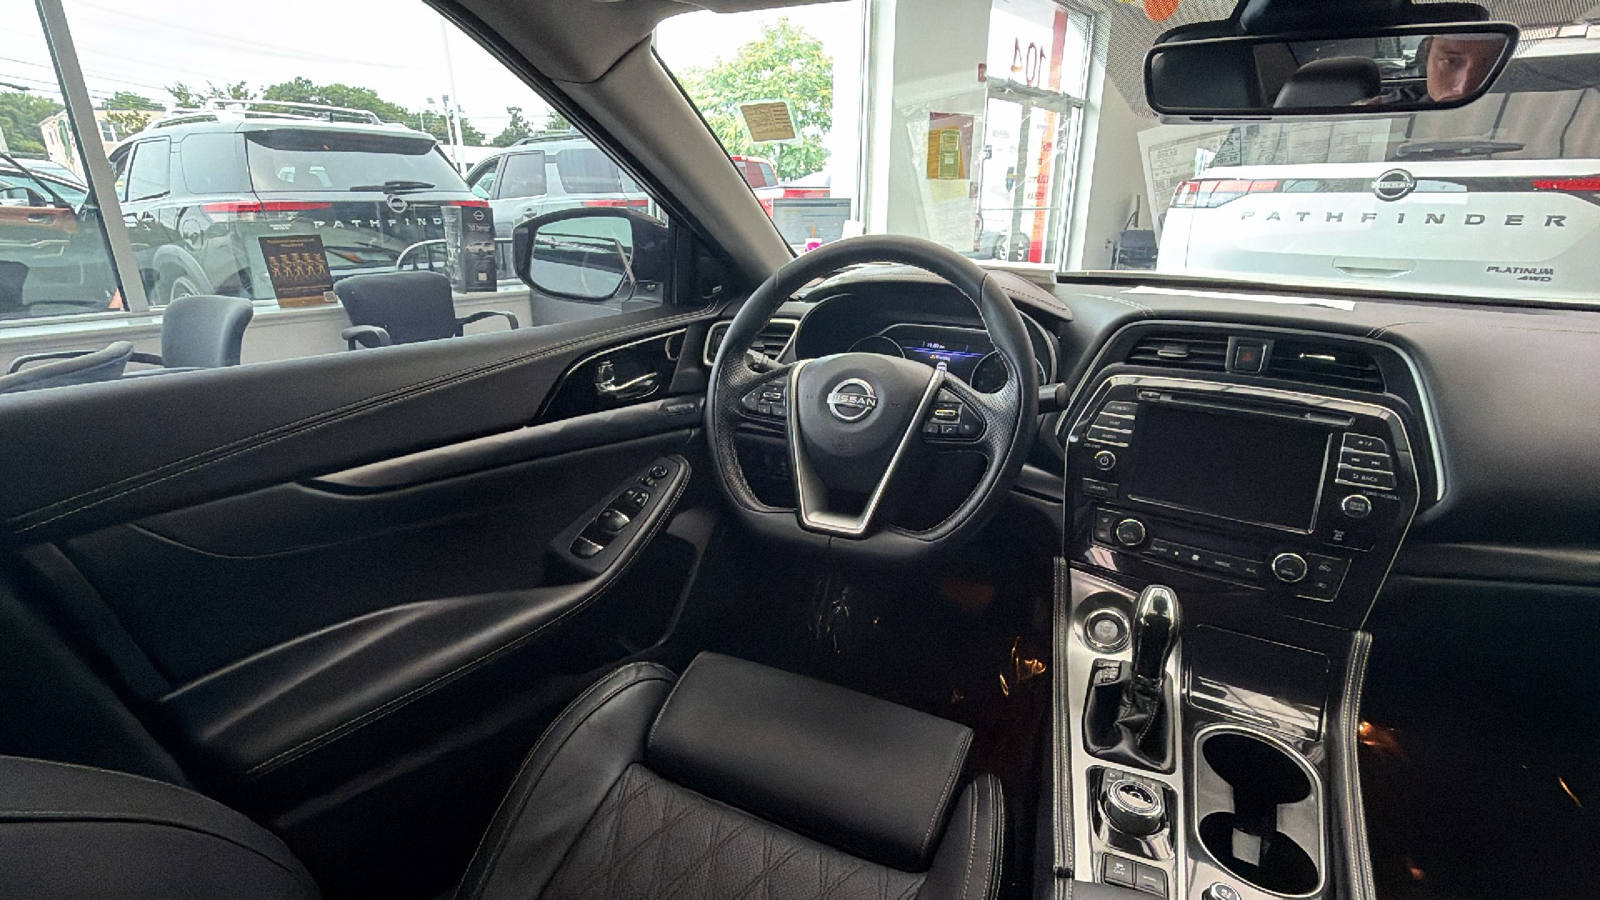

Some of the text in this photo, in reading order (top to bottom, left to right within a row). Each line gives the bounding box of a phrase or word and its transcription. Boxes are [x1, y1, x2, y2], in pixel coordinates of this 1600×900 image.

[1241, 210, 1567, 228] PATHFINDER
[1486, 266, 1554, 276] PLATINUM
[827, 393, 876, 407] NISSAN
[1361, 475, 1378, 483] BACK
